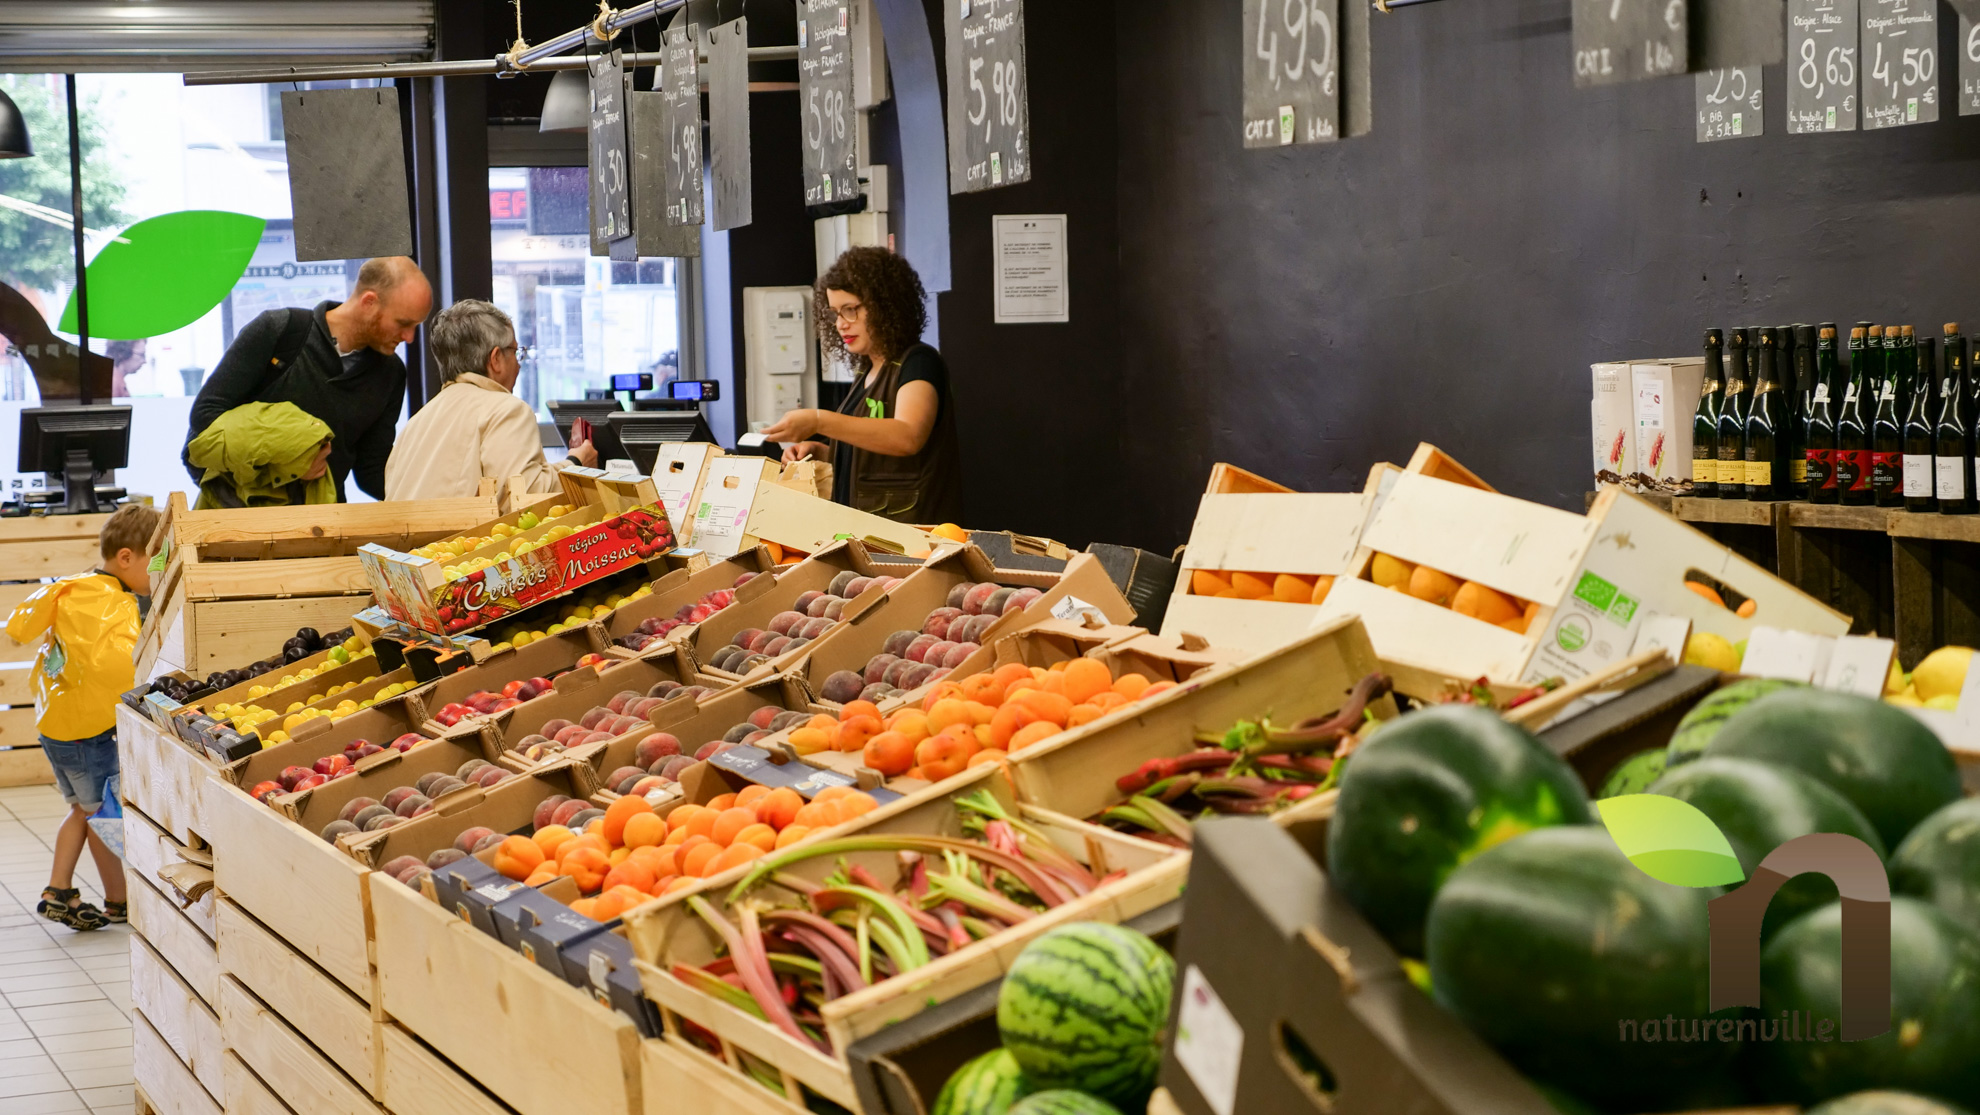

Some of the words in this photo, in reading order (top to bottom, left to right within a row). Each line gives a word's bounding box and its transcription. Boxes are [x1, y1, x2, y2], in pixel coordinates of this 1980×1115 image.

[988, 12, 1014, 34] FRANCE
[1793, 15, 1819, 32] Origine:
[1822, 13, 1843, 25] Alsace
[1866, 17, 1897, 34] Origine:
[1897, 10, 1934, 25] Normandie
[1257, 0, 1331, 91] 4,95
[821, 52, 843, 68] FRANCE
[1575, 49, 1599, 76] CAT
[1799, 38, 1855, 100] 8,65
[1872, 42, 1934, 100] 4,50
[680, 83, 696, 98] FRANCE
[1323, 70, 1335, 97] €
[968, 57, 1017, 143] 5,98
[1749, 89, 1762, 111] €
[1842, 95, 1854, 112] €
[1922, 86, 1936, 104] €
[1800, 110, 1824, 122] bouteille
[1874, 105, 1901, 117] bouteille
[1886, 115, 1897, 126] 75
[808, 86, 845, 169] 5,98
[1245, 120, 1265, 140] CAT
[1805, 121, 1815, 132] 75
[671, 114, 697, 191] 4,98
[1015, 130, 1024, 155] €
[598, 143, 624, 210] 4,30
[967, 165, 981, 181] CAT
[569, 532, 608, 553] région
[561, 543, 638, 588] Moissac
[464, 568, 547, 611] Cerises
